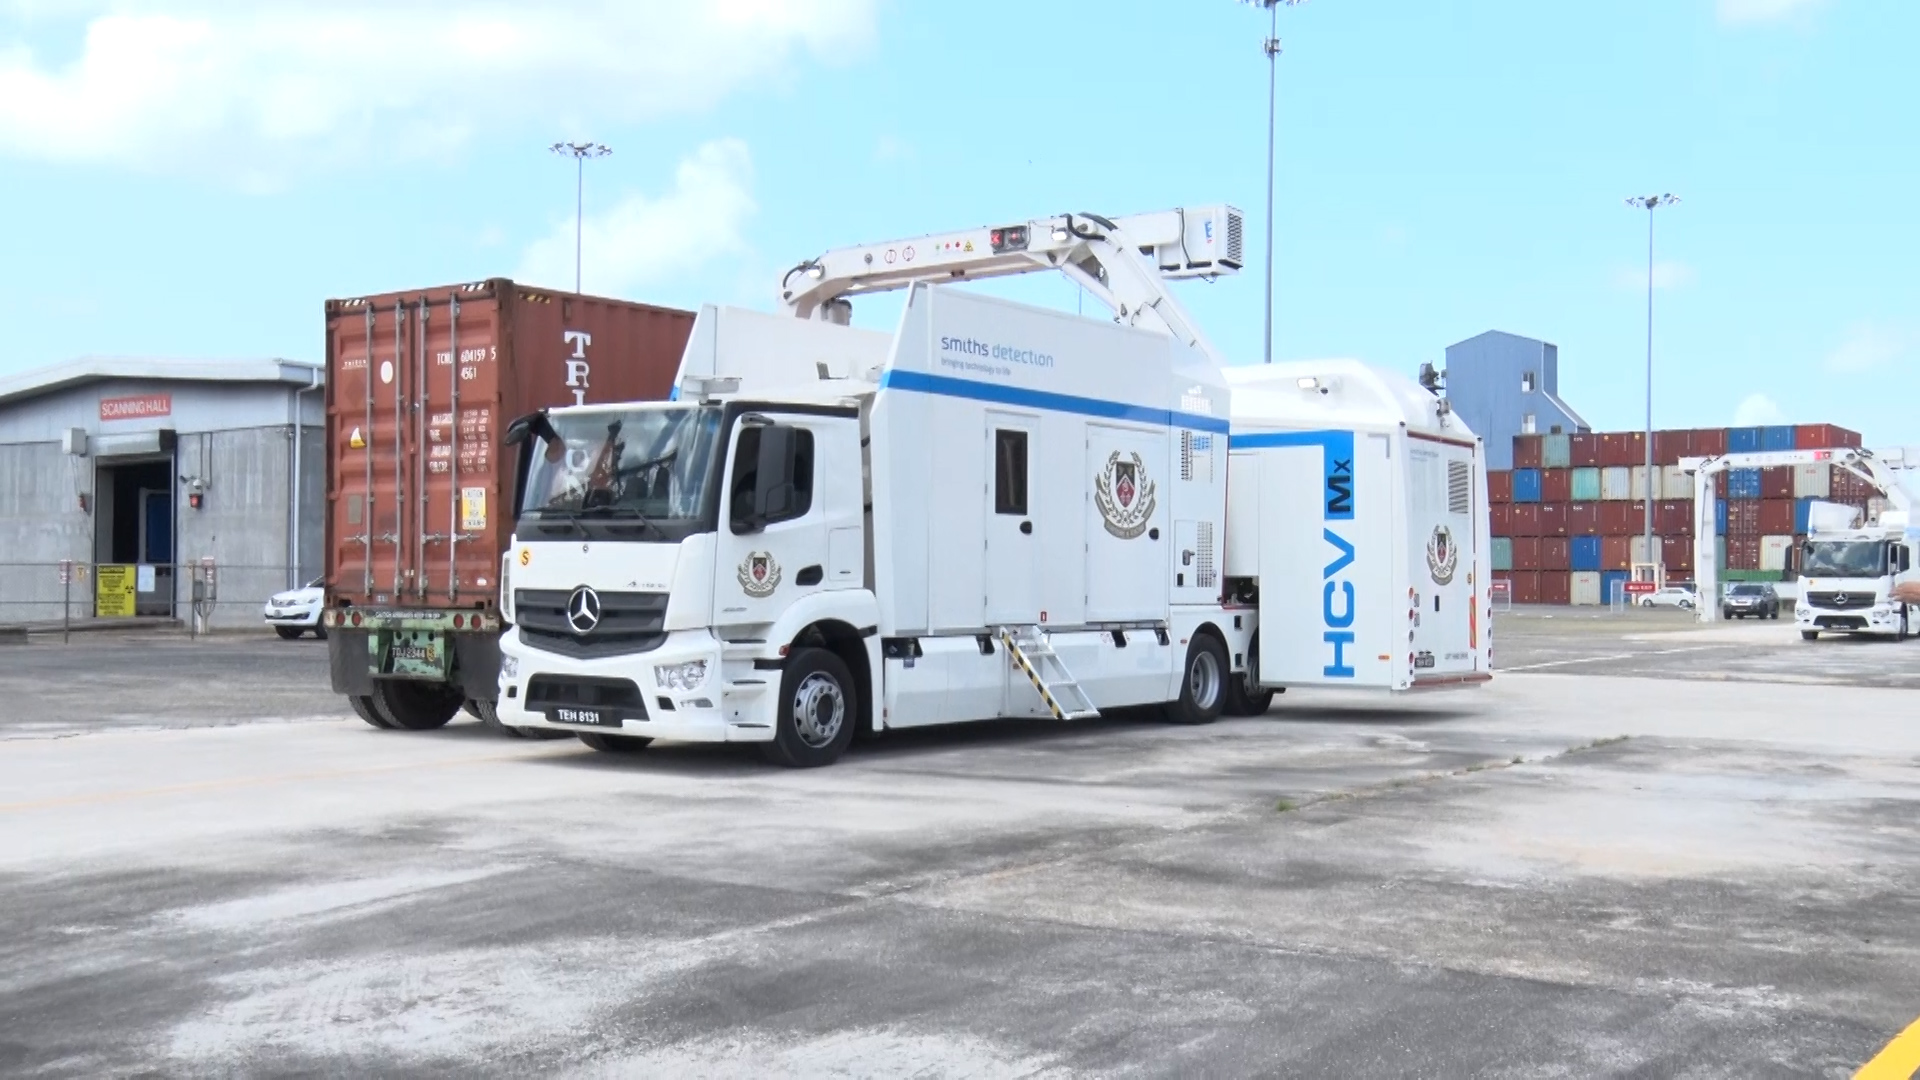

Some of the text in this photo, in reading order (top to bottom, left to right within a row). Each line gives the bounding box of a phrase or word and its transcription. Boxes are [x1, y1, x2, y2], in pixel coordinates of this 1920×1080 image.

[460, 349, 486, 363] 604159
[490, 346, 497, 361] 5
[941, 336, 1054, 368] smiths detection
[101, 399, 169, 416] SCANNING HALL
[1323, 527, 1355, 678] HCV
